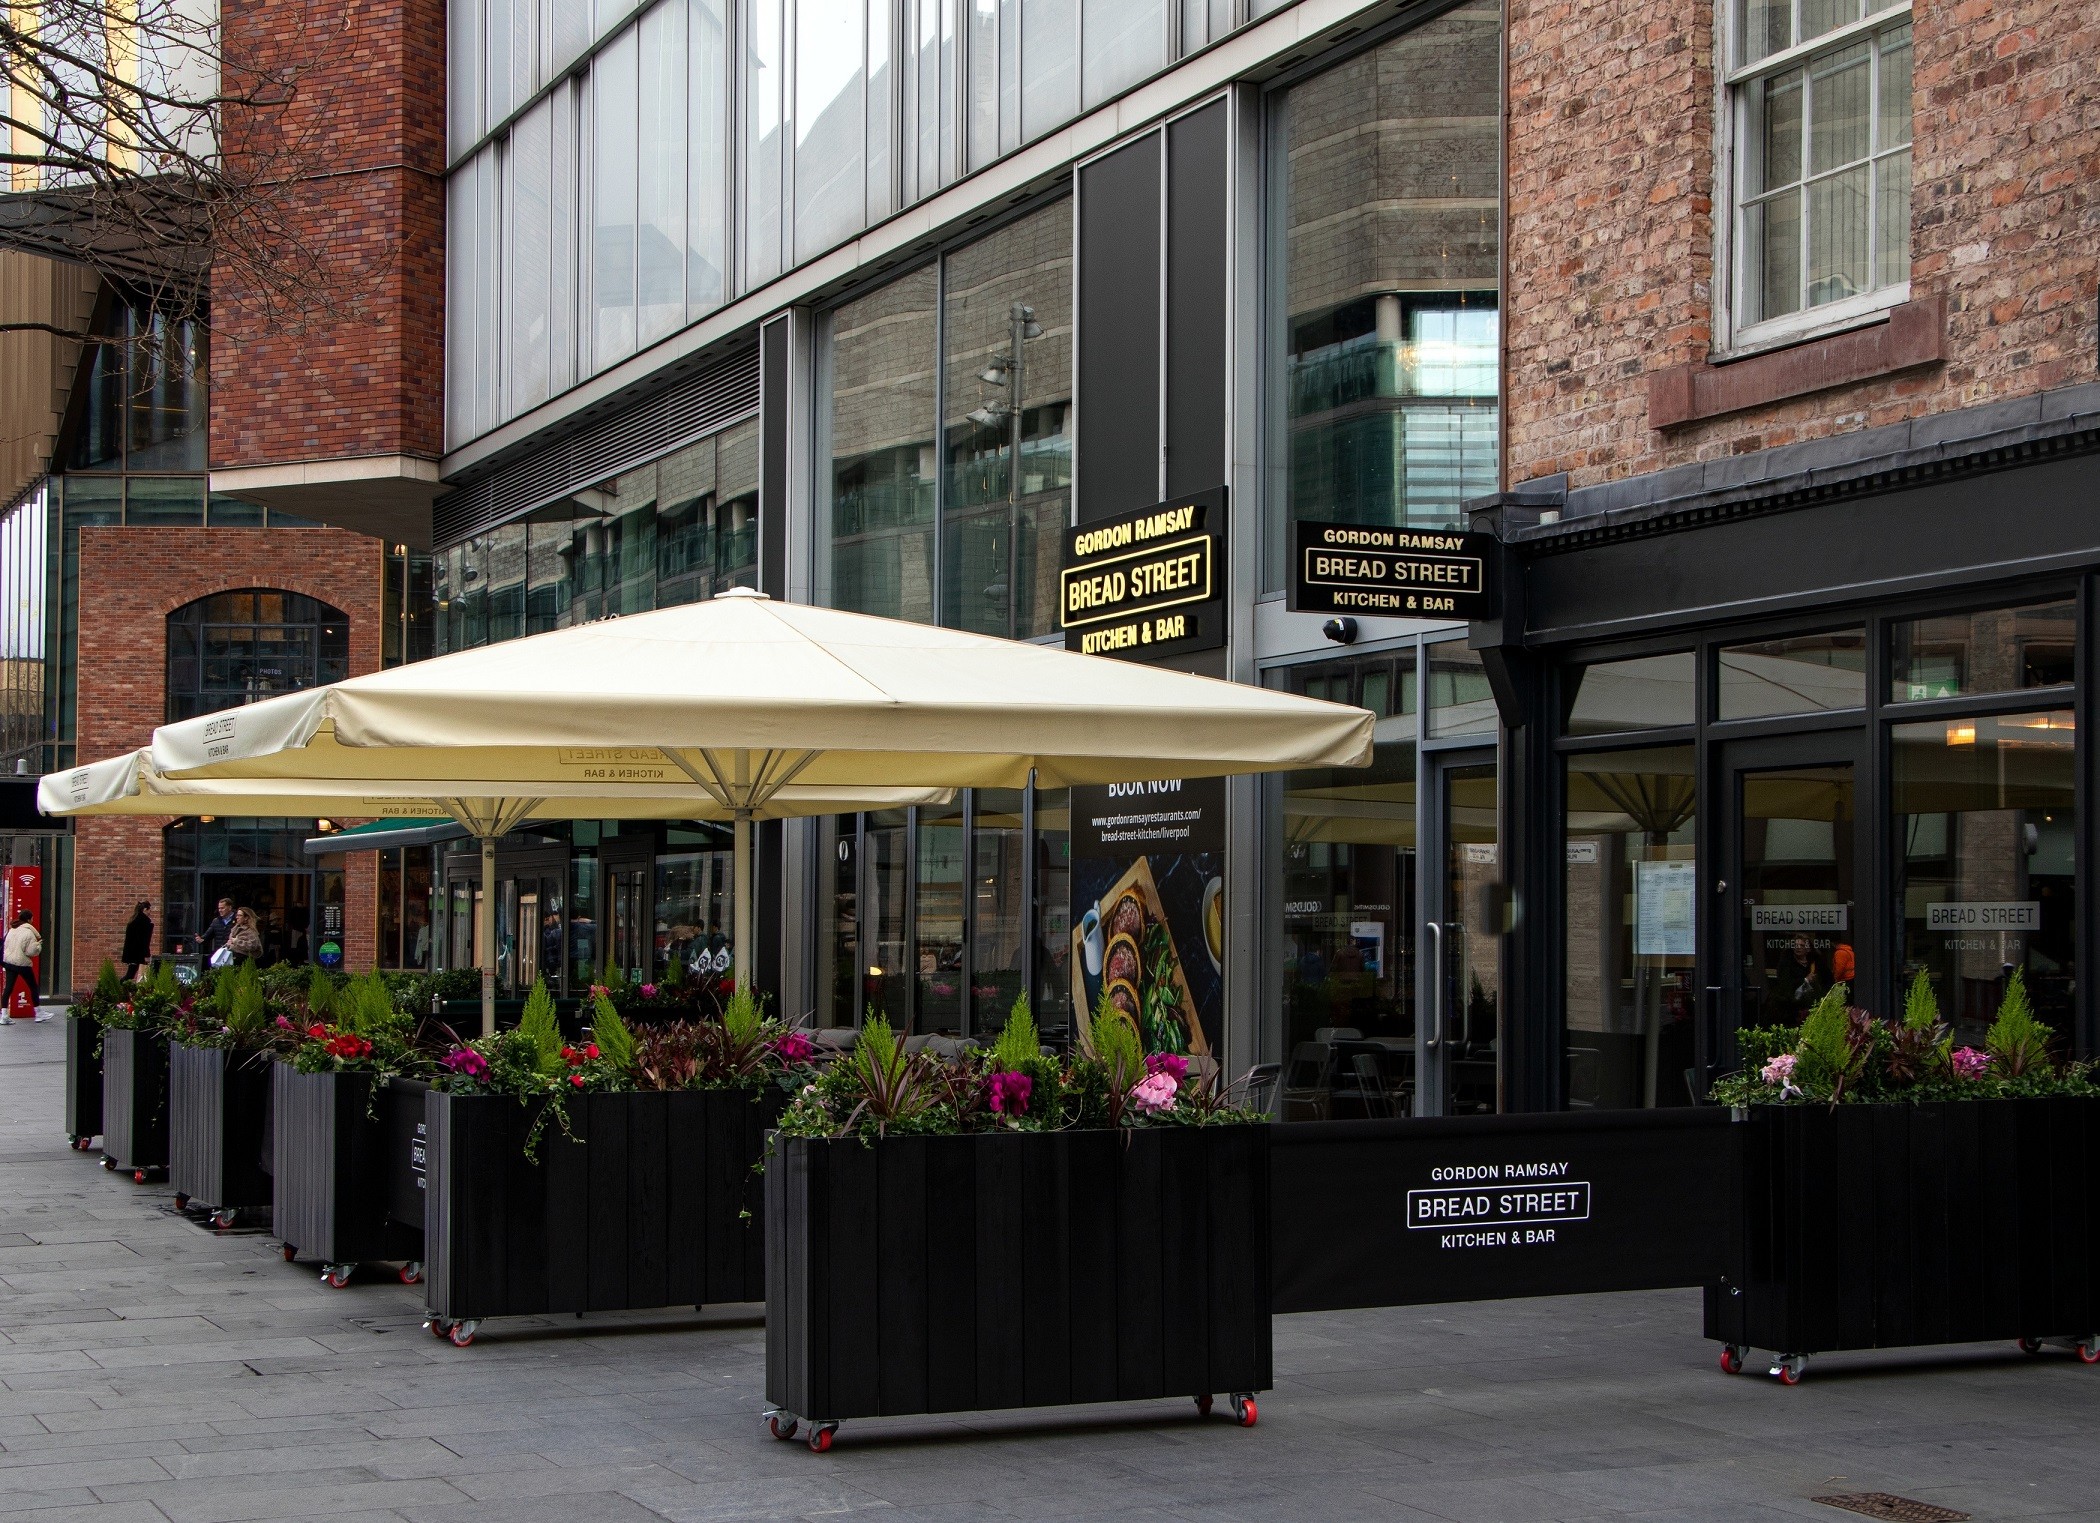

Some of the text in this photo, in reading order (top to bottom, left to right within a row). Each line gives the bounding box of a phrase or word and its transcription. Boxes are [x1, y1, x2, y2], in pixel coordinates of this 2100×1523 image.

[1075, 506, 1195, 556] GORDON RAMSAY
[1324, 529, 1464, 551] GORDON RAMSAY
[1316, 557, 1472, 584] BREAD STREET
[1069, 553, 1200, 611] BREAD STREET
[1333, 591, 1455, 611] KITCHEN & BAR
[1082, 615, 1185, 655] KITCHEN & BAR
[1091, 808, 1202, 829] www.gordonramsayrestaurants.com/
[1101, 826, 1190, 842] bread-street-kitchen/liverpool
[1756, 910, 1842, 925] BREAD STREET
[1932, 908, 2034, 924] BREAD STREET
[1766, 939, 1831, 949] KITCHEN & BAR
[1944, 940, 1986, 950] KITCHEN
[1989, 940, 1996, 950] &
[1431, 1162, 1569, 1181] GORDON RAMSAY
[1418, 1191, 1579, 1218] BREAD STREET
[1441, 1229, 1556, 1248] KITCHEN & BAR
